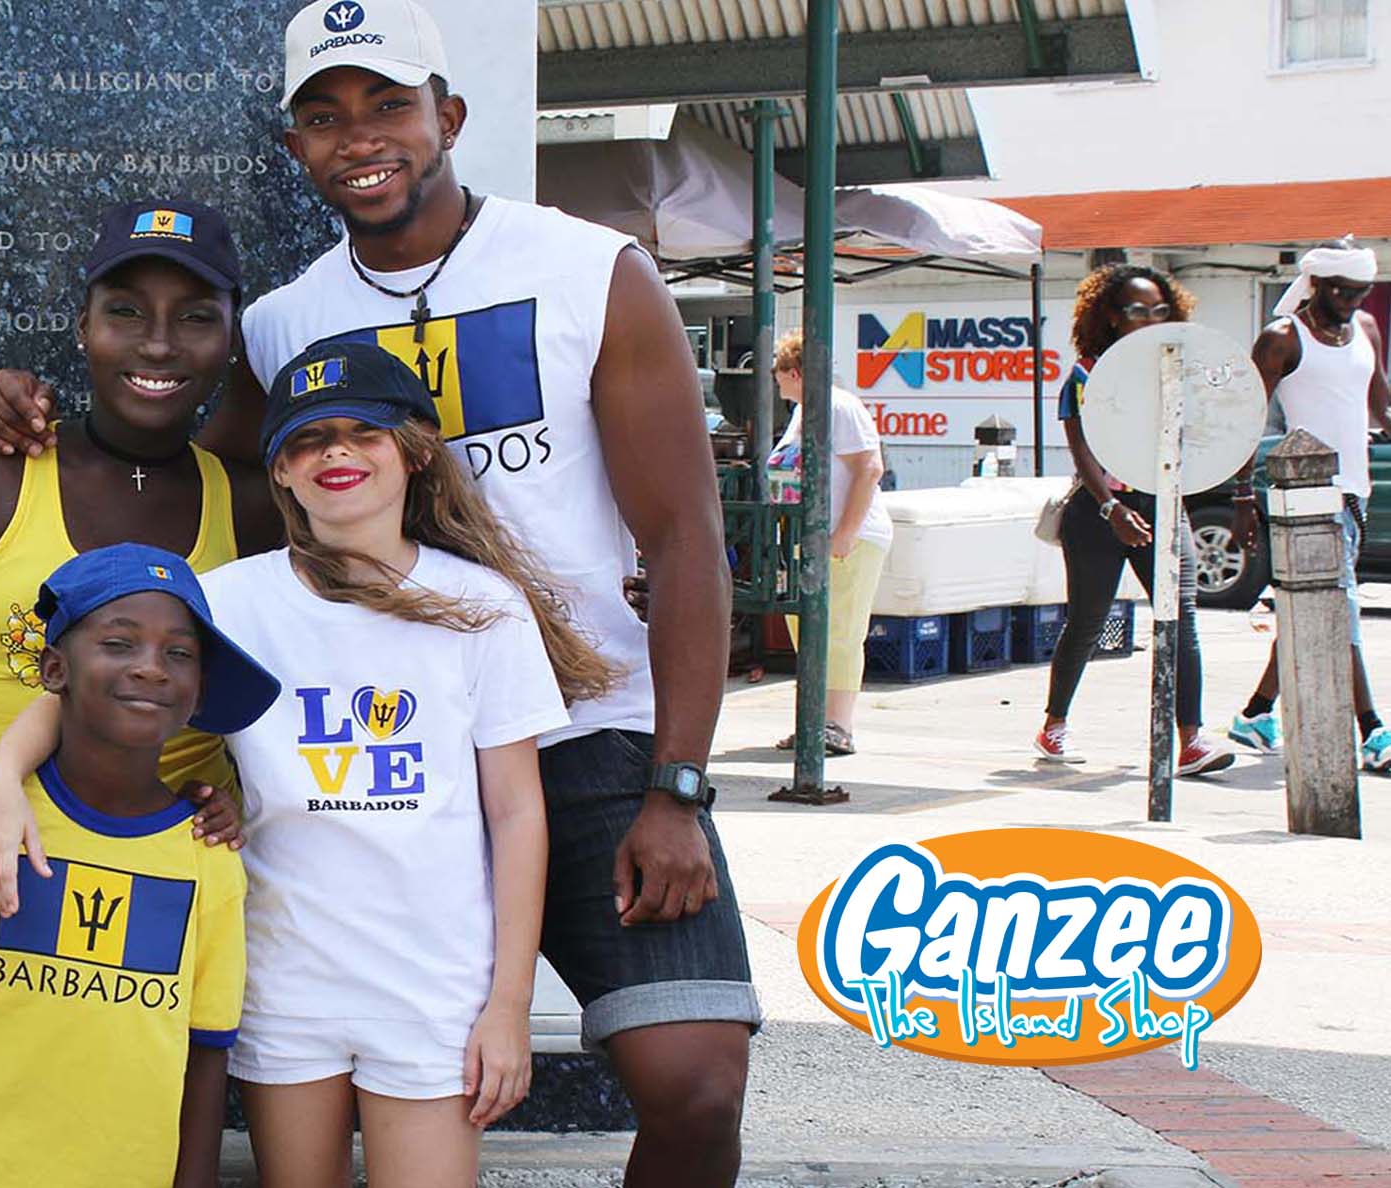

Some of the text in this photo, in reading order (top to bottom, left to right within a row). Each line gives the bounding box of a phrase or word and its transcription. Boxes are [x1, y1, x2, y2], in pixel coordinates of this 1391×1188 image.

[309, 33, 386, 58] BARBADOS
[52, 71, 216, 93] ALLEGIANCE
[239, 73, 276, 93] TO
[123, 154, 268, 175] BARBADOS
[33, 231, 72, 251] TO
[927, 316, 1047, 349] MASSY
[926, 350, 1061, 382] STORES
[307, 799, 419, 812] BARBADOS
